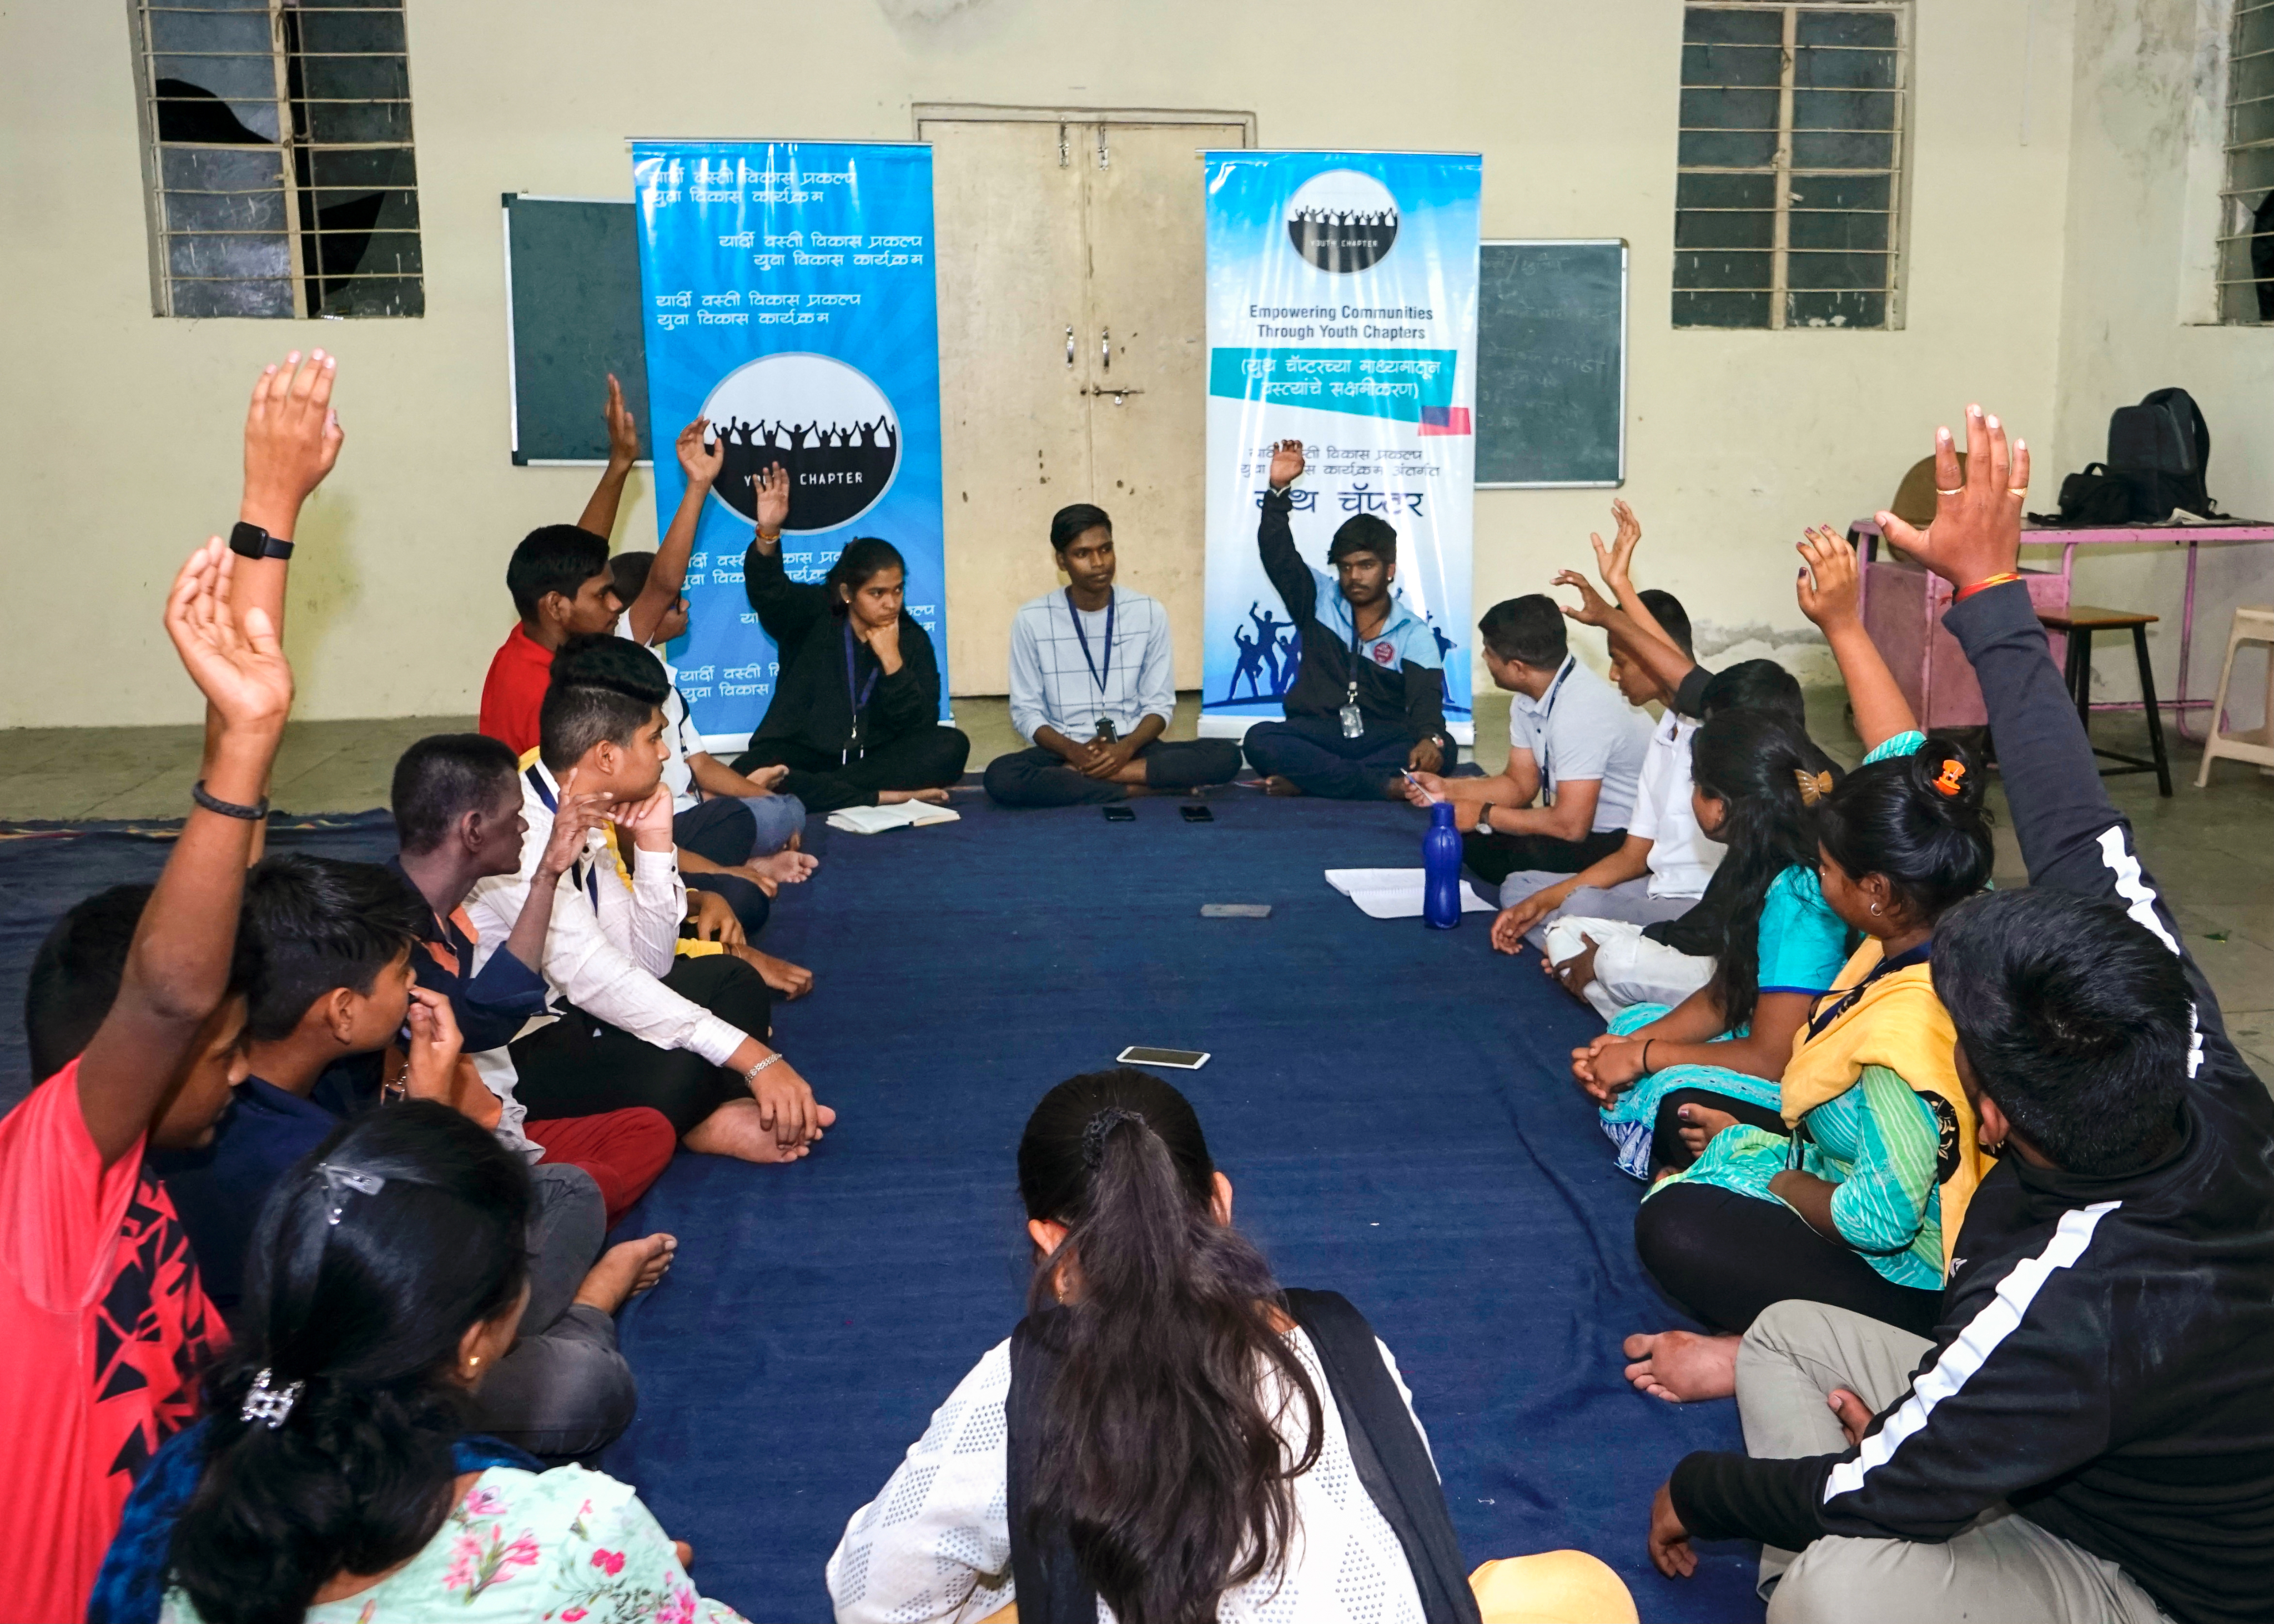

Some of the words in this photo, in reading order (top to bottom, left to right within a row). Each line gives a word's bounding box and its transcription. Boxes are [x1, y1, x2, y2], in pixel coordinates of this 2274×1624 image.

[800, 172, 856, 185] प्रकल्प
[690, 187, 743, 203] विकास
[752, 187, 824, 204] कार्यक्रम
[718, 231, 756, 248] यार्दी
[763, 230, 803, 248] वस्ती
[811, 232, 862, 248] विकास
[868, 235, 923, 248] प्रकल्प
[753, 254, 785, 271] युवा
[793, 250, 844, 267] विकास
[852, 250, 923, 267] कार्यक्रम
[655, 290, 693, 308] यार्दी
[701, 290, 741, 307] वस्ती
[748, 290, 800, 306] विकास
[806, 294, 861, 307] प्रकल्प
[657, 314, 690, 330] युवा
[697, 309, 749, 325] विकास
[758, 309, 829, 326] कार्यक्रम
[1250, 305, 1336, 321] Empowering
[1342, 305, 1433, 320] Communities
[1257, 324, 1315, 340] Through
[1319, 325, 1358, 339] Youth
[1363, 325, 1426, 341] Chapters
[1360, 359, 1441, 380] माध्यमातून
[1326, 446, 1370, 460] विकास
[1375, 450, 1422, 460] प्रकल्प
[800, 472, 863, 485] CHAPTER
[679, 665, 716, 682] यार्दी
[723, 662, 762, 680] वस्ती
[681, 686, 712, 703] युवा
[719, 681, 769, 697] विकास
